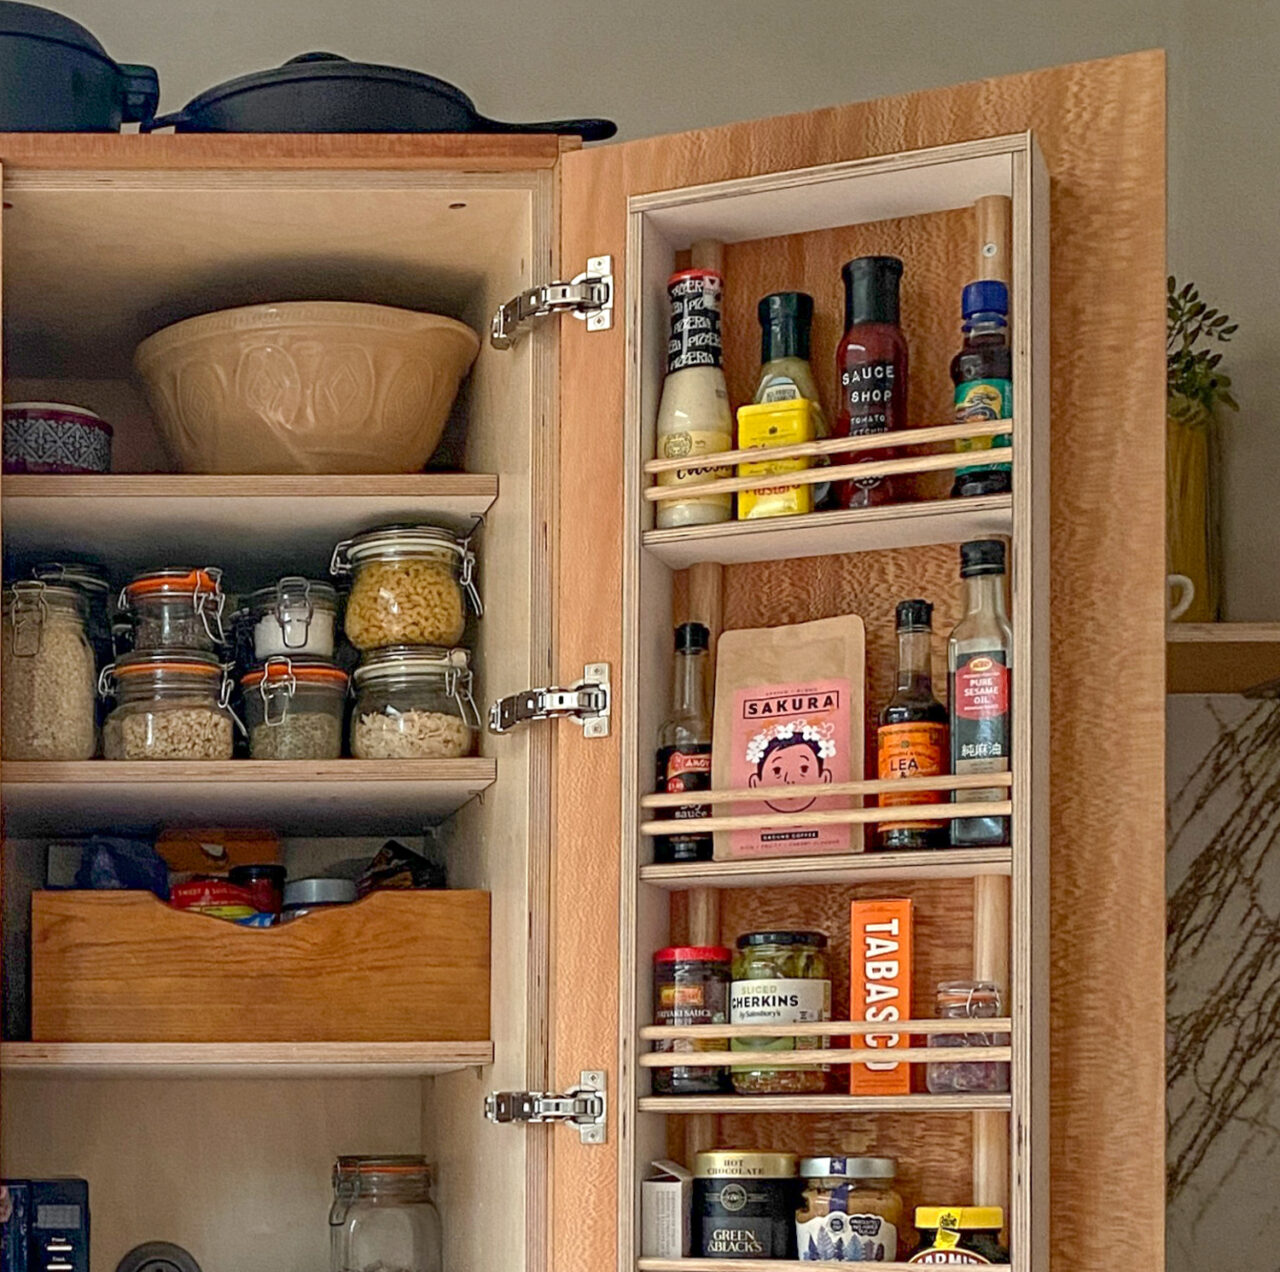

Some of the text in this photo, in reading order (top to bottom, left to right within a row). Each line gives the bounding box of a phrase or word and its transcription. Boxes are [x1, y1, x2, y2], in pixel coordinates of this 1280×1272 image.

[842, 365, 895, 386] SAUCE
[851, 389, 893, 403] SHOP
[850, 414, 886, 425] TOMATO
[970, 678, 993, 687] PURE
[964, 686, 999, 697] SESAME
[748, 695, 834, 715] SAKURA
[974, 696, 990, 704] OIL
[890, 758, 919, 772] LEA
[675, 811, 708, 819] sauce
[741, 985, 778, 995] SLICED
[724, 1159, 744, 1167] HOT
[707, 1167, 765, 1175] CHOCOLATE
[713, 1229, 755, 1241] GREEN
